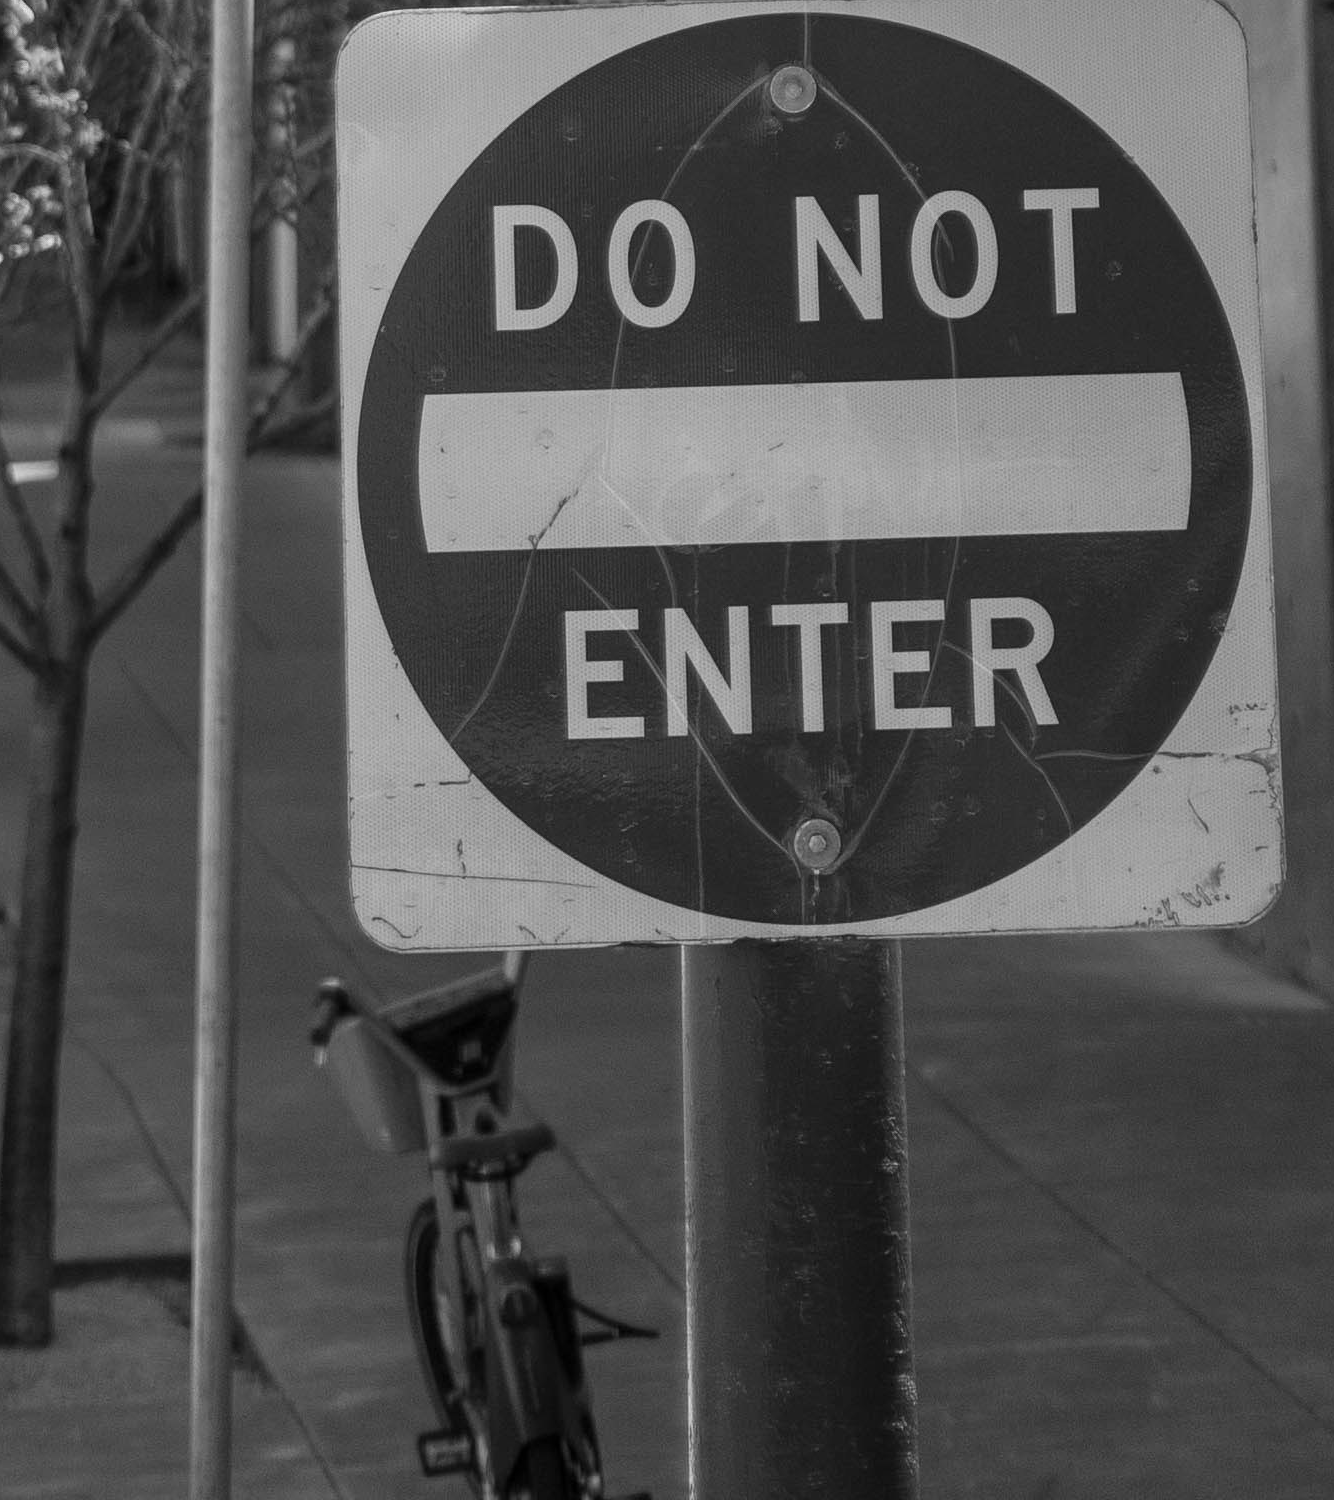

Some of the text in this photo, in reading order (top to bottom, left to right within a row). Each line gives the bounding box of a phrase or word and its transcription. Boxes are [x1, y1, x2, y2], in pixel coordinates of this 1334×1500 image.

[492, 187, 1100, 332] DO NOT
[564, 596, 1060, 740] ENTER
